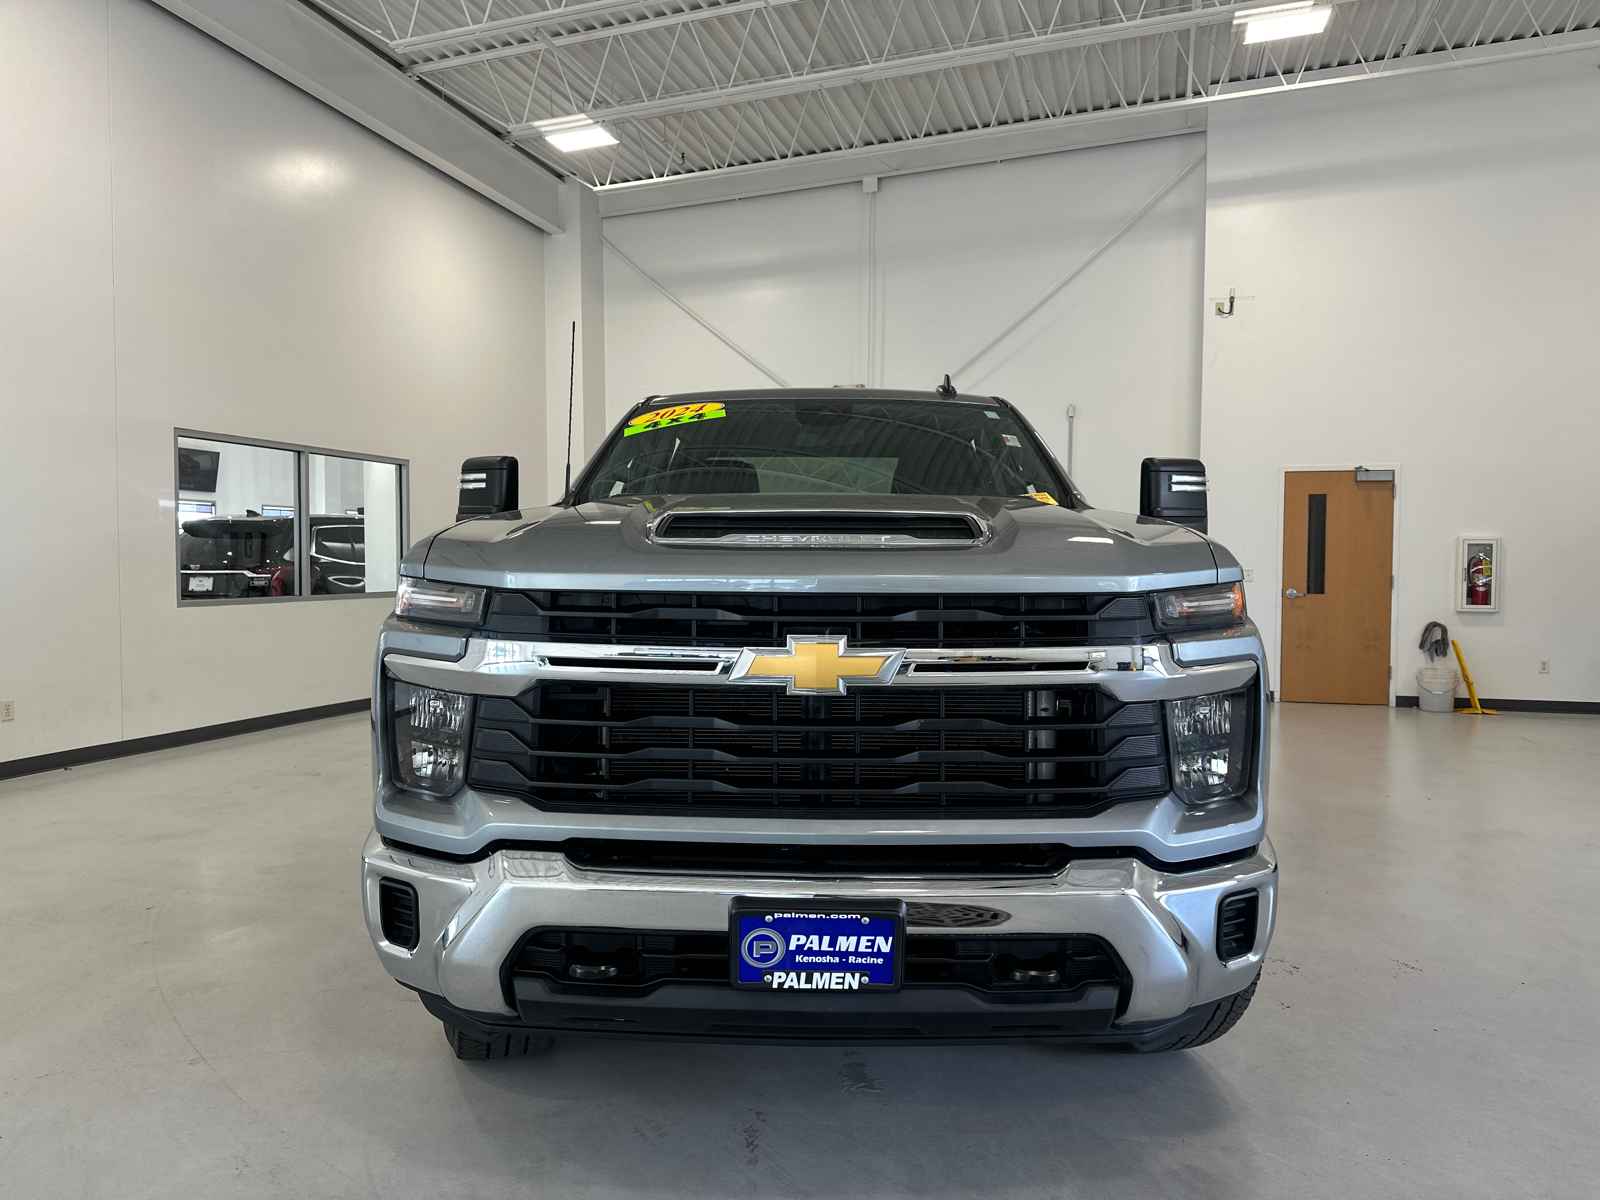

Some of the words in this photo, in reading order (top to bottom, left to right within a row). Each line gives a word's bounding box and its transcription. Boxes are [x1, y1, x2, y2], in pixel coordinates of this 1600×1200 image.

[643, 403, 708, 424] 2024
[788, 934, 893, 953] PALMEN
[795, 955, 840, 963] Kenosha
[848, 956, 884, 964] Racine
[772, 971, 860, 990] PALMEN
